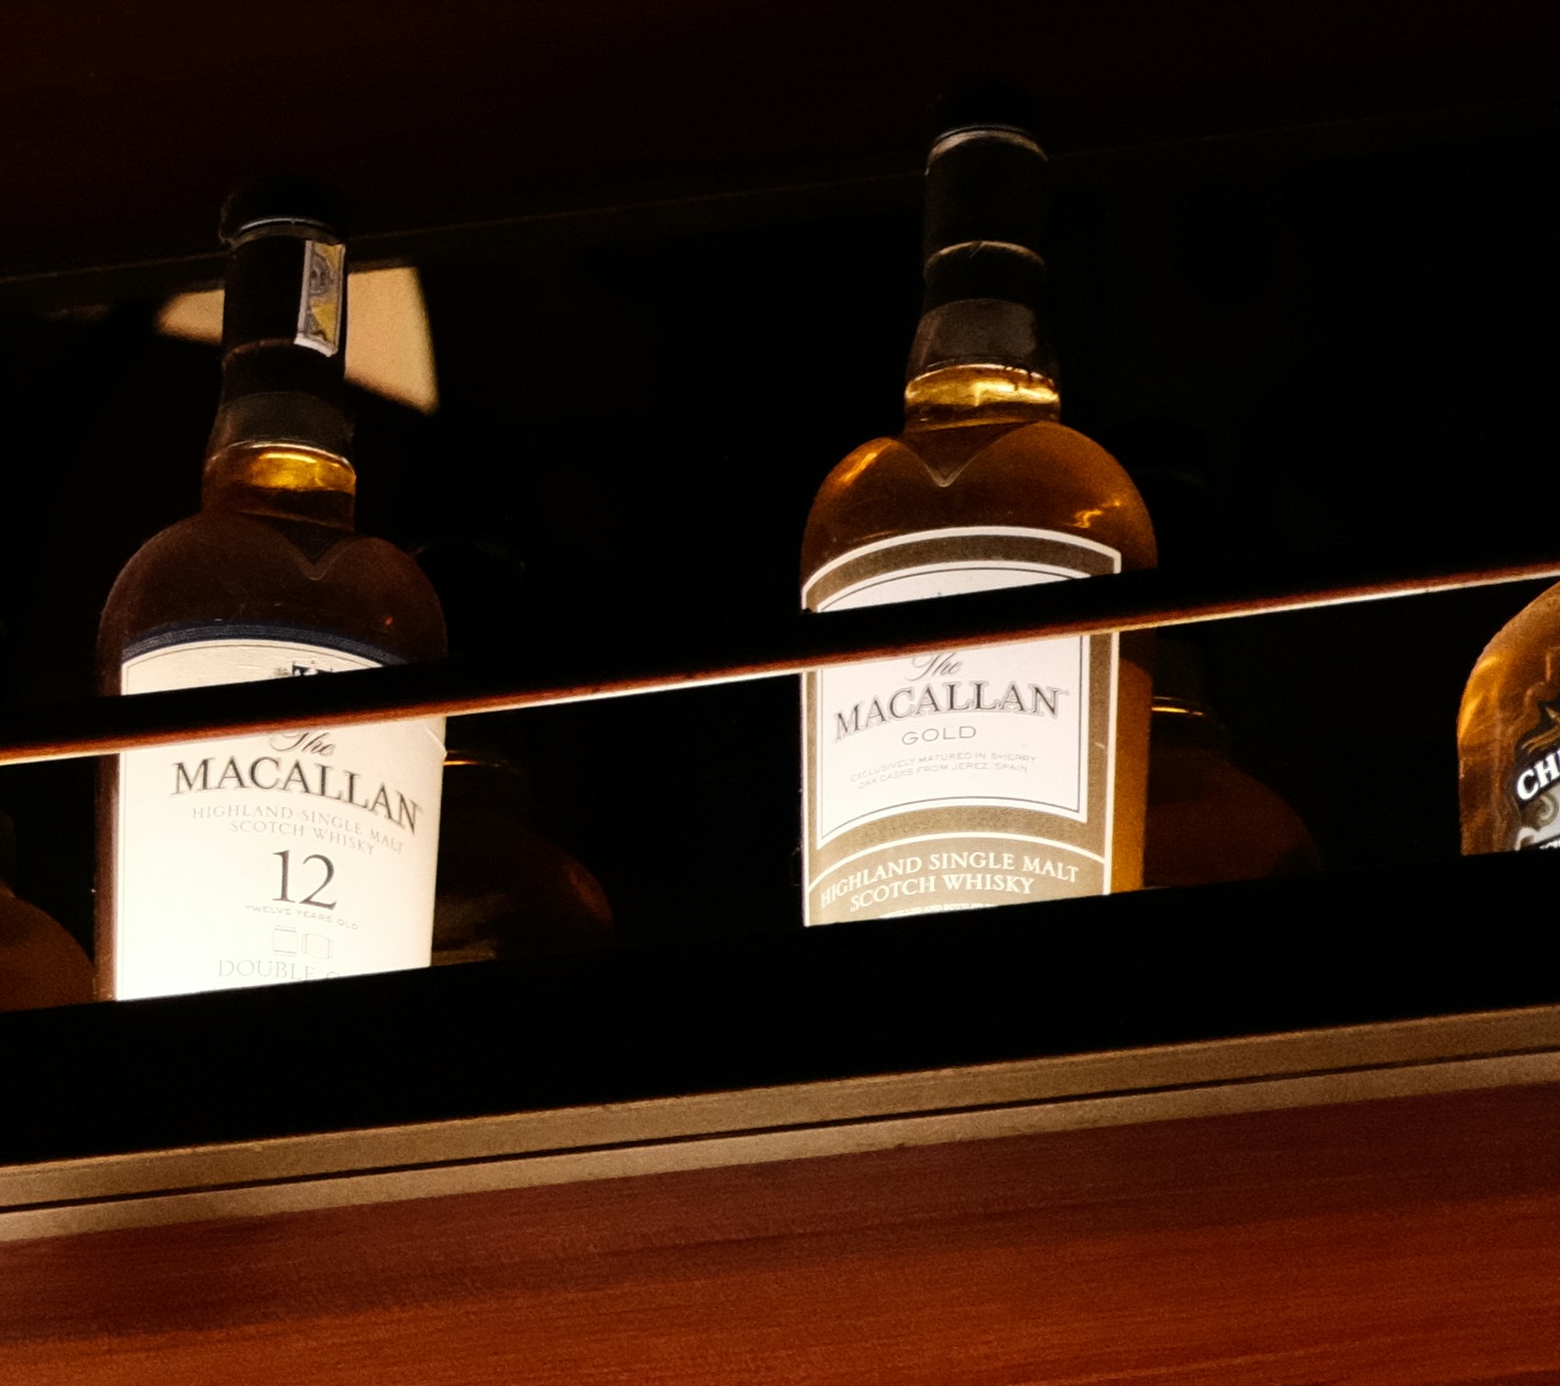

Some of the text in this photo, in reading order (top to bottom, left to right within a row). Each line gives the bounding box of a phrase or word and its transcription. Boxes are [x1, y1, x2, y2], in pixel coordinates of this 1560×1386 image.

[904, 652, 964, 683] The
[833, 680, 1064, 744] MACALLAN
[268, 730, 337, 757] The
[900, 725, 978, 747] GOLD
[916, 763, 949, 775] FROM
[918, 751, 973, 763] MATURED
[974, 751, 987, 761] IN
[170, 755, 424, 836] MACALLAN
[192, 803, 405, 855] HIGHLAND SINGLE MALT
[230, 818, 376, 856] SCOTCH WHISKY
[270, 849, 338, 912] 12
[820, 856, 923, 910] HIGHLAND
[929, 851, 1017, 872] SINGLE
[1022, 858, 1081, 884] MALT
[850, 875, 937, 912] SCOTCH
[942, 872, 1036, 896] WHISKY
[244, 904, 359, 931] TWELVE YEARS OLD
[217, 959, 315, 981] DOUBLE
